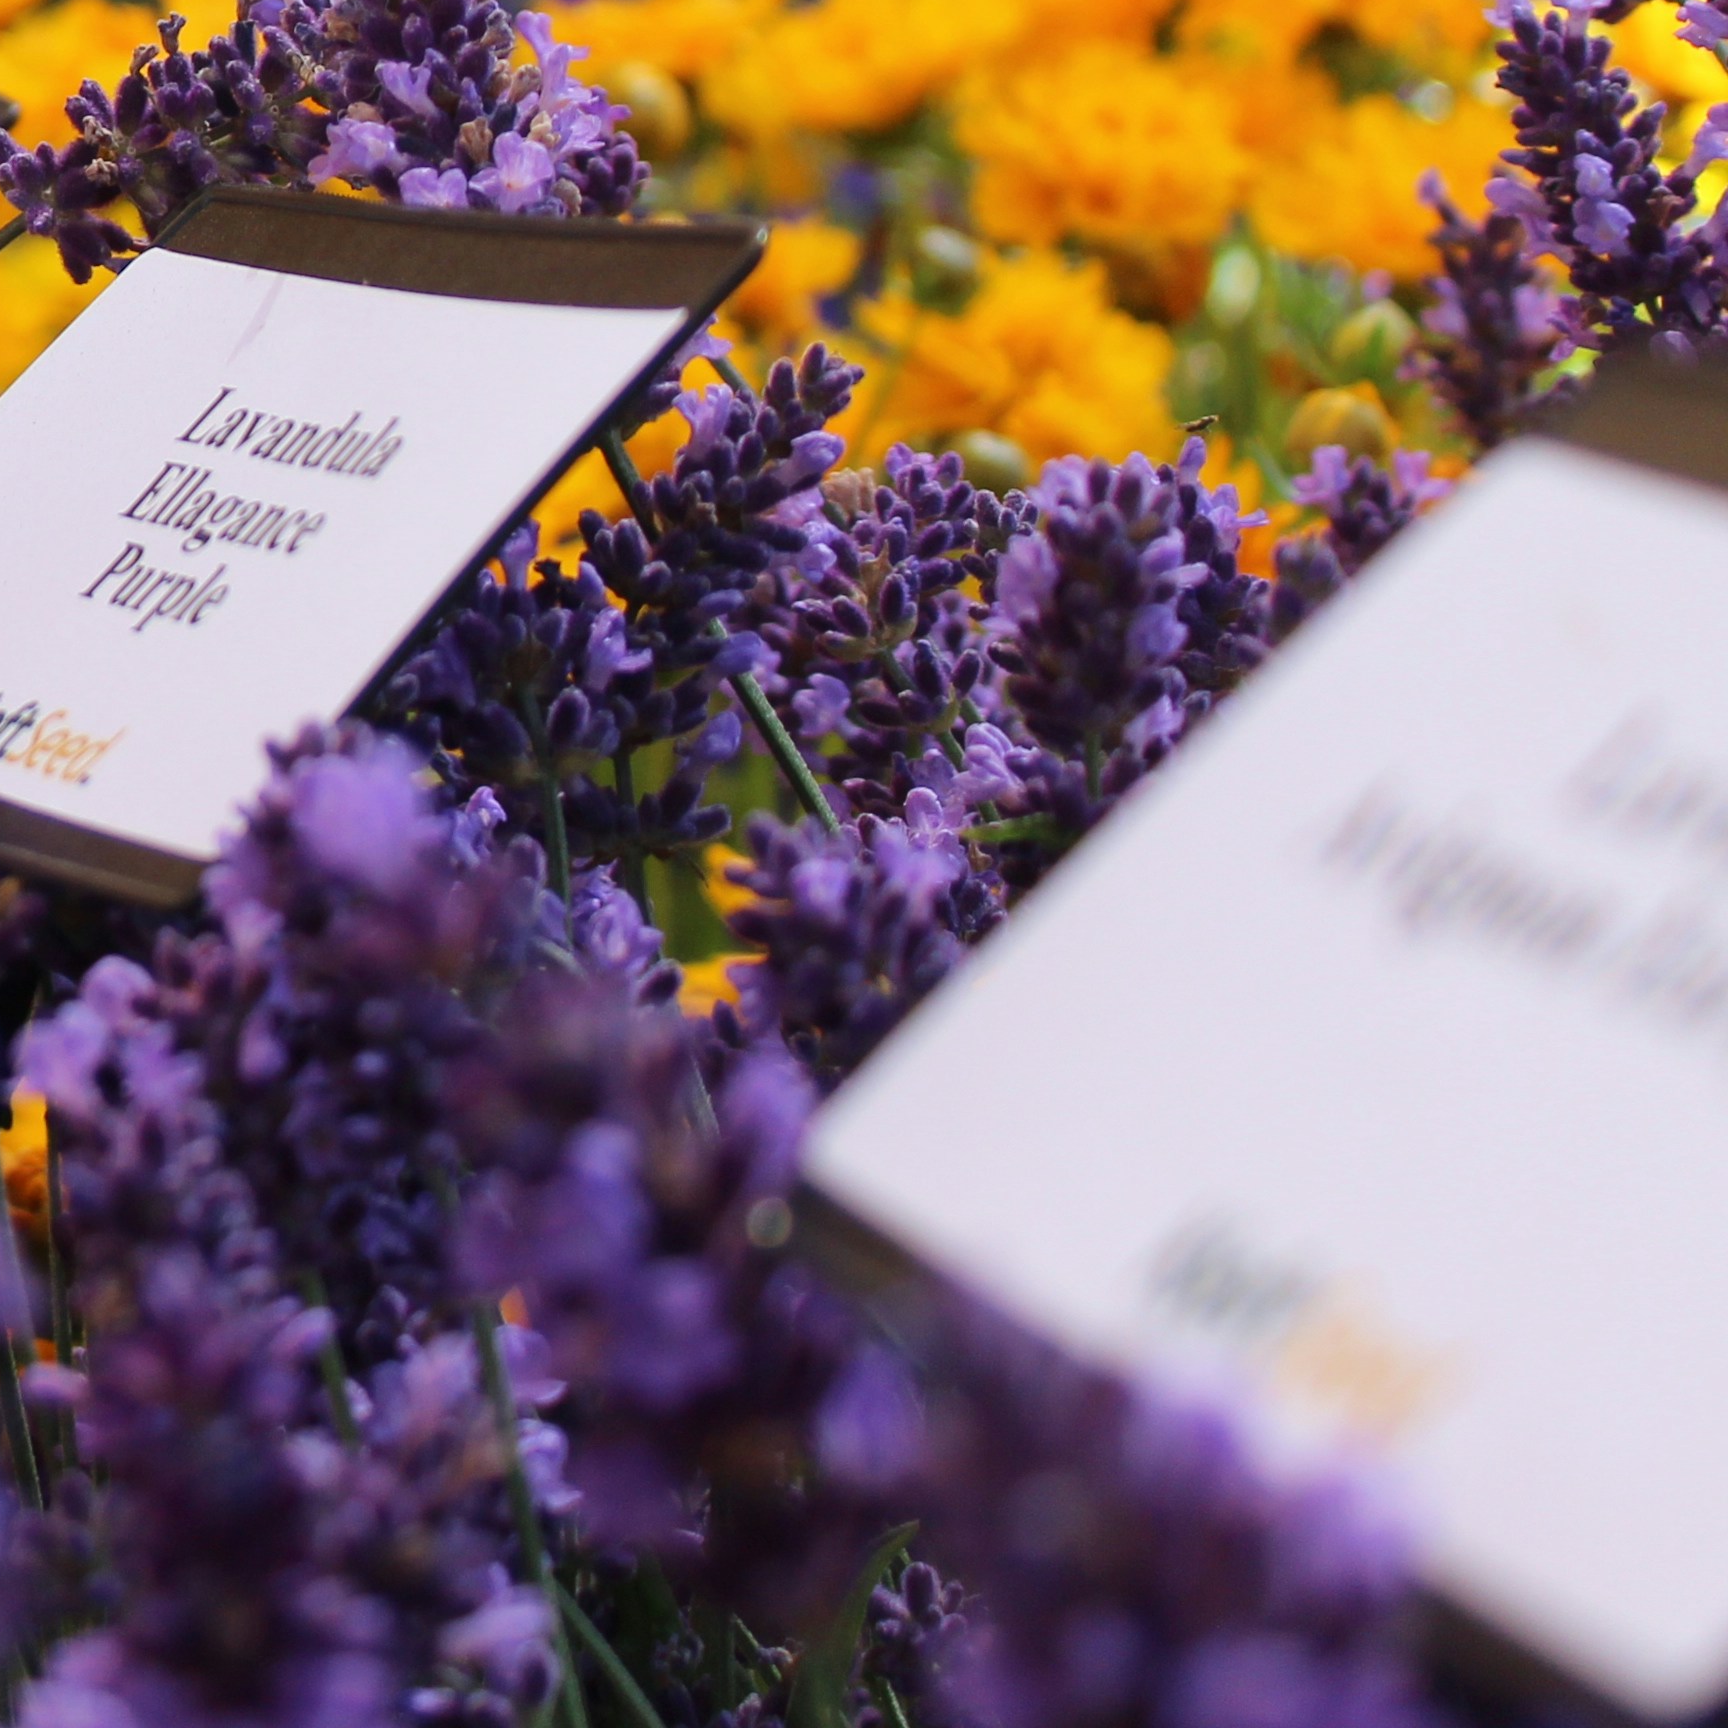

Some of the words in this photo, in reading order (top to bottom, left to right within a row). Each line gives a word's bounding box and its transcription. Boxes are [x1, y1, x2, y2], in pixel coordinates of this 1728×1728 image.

[175, 385, 404, 477] Lavandula
[118, 460, 327, 554] Ellagance
[78, 541, 231, 632] Purple
